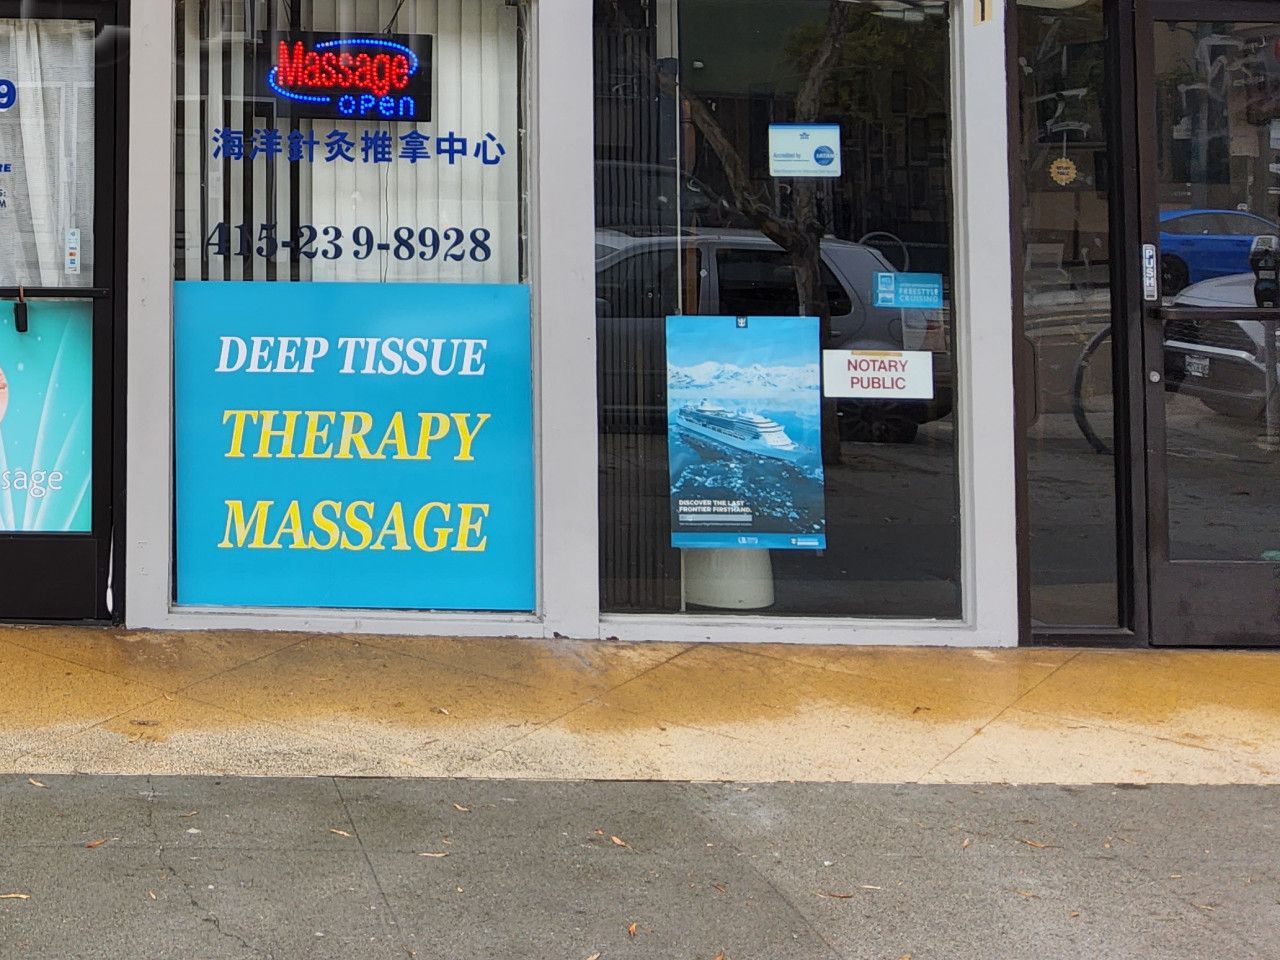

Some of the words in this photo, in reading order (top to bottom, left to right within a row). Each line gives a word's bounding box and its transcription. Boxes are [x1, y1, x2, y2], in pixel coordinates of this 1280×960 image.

[277, 40, 411, 96] Massage
[211, 127, 507, 166] 海洋針灸推拿中心
[206, 222, 492, 263] 415-239-8928
[1144, 249, 1155, 288] PUSH
[215, 335, 329, 373] DEEP
[337, 337, 488, 376] TISSUE
[847, 358, 909, 374] NOTARY
[849, 375, 907, 391] PUBLIC
[222, 409, 491, 461] THERAPY
[728, 499, 745, 507] LAST
[218, 500, 490, 553] MASSAGE
